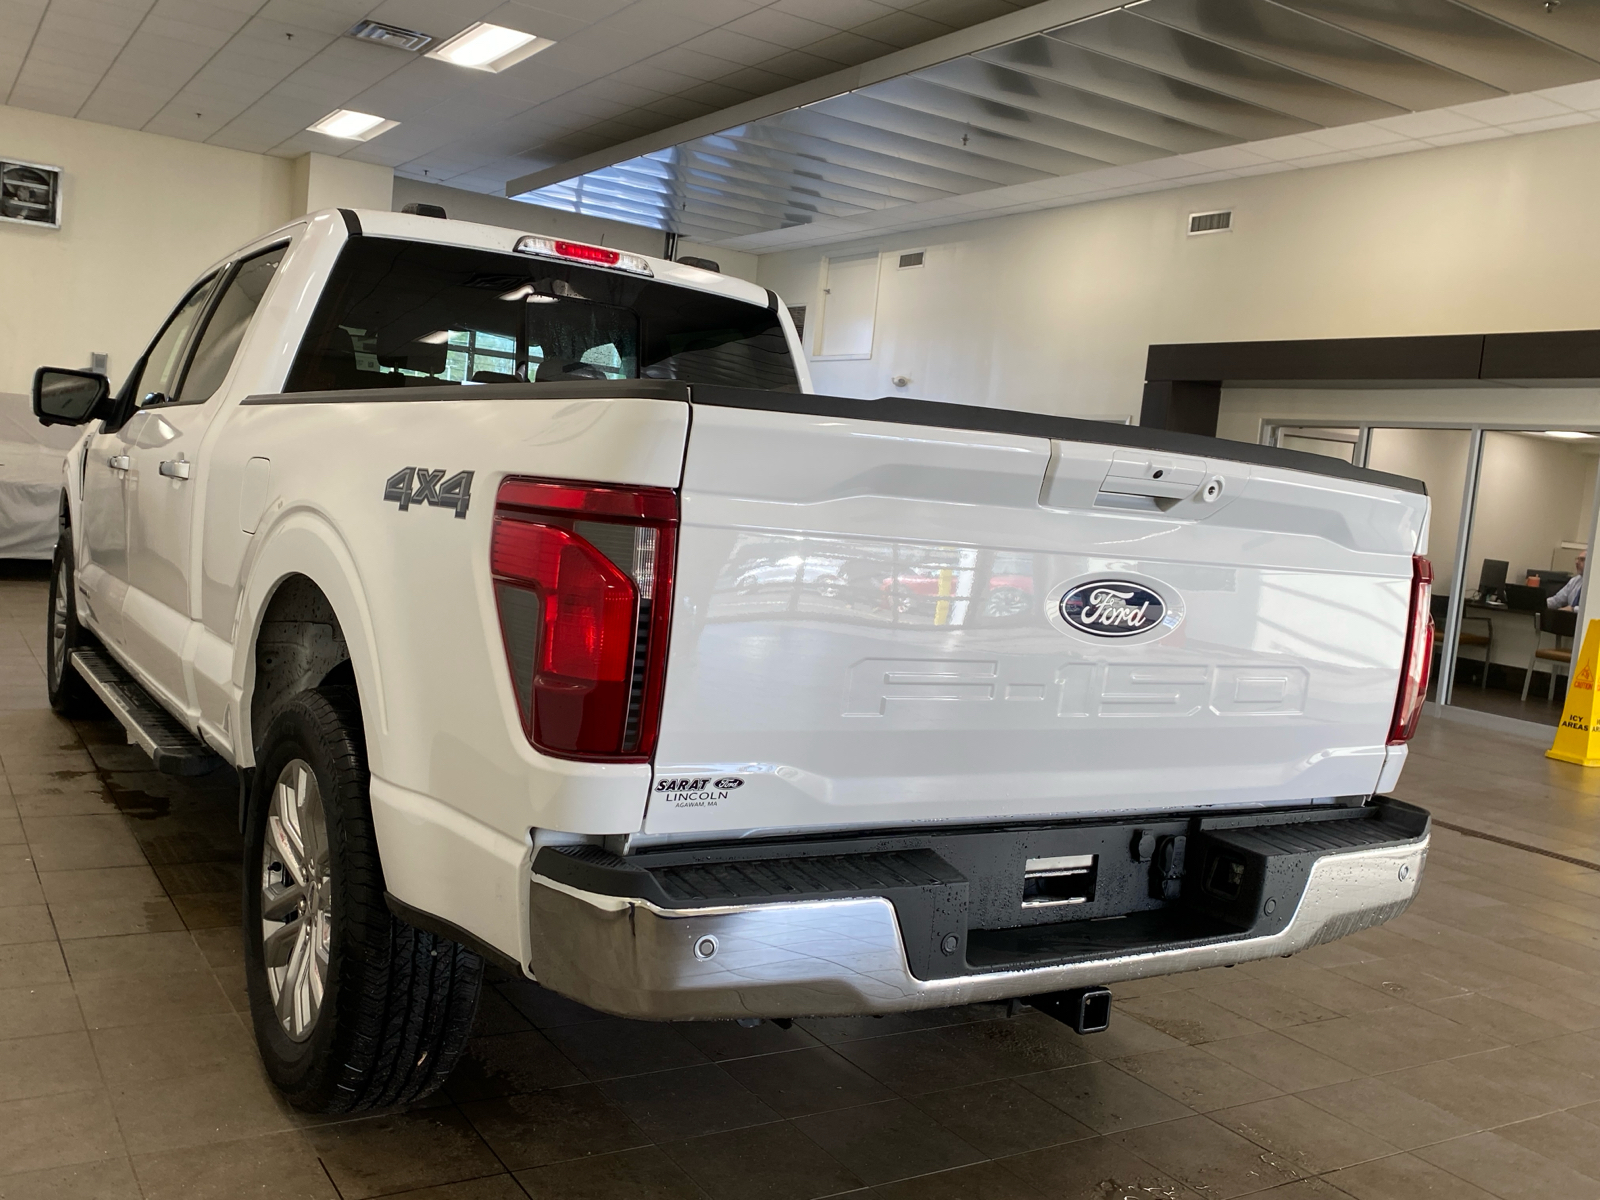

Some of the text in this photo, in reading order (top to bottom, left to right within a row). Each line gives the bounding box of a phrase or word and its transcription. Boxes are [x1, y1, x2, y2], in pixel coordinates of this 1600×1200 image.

[1081, 588, 1149, 627] Ford
[840, 656, 1311, 718] F-150
[1569, 714, 1584, 723] ICY
[1561, 720, 1589, 732] AREAS
[655, 778, 743, 792] SARAT Ford
[666, 791, 728, 802] LINCOLN
